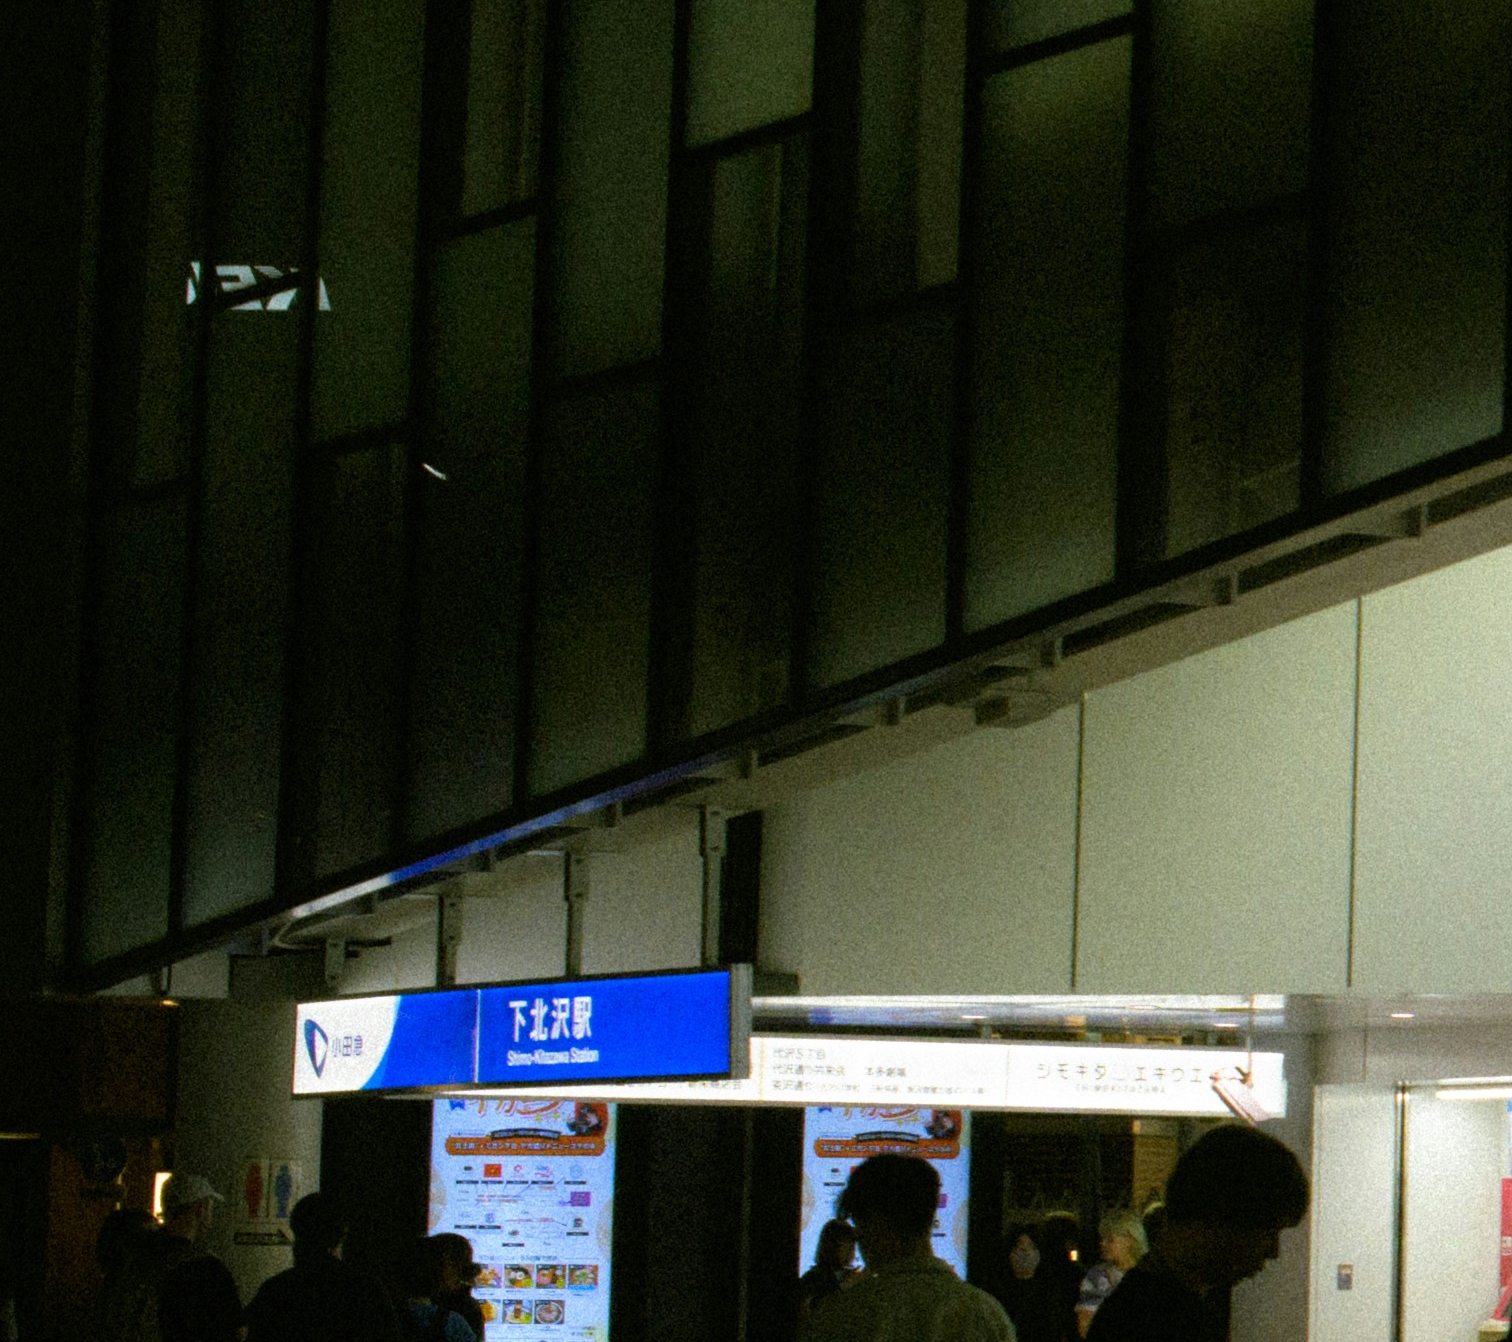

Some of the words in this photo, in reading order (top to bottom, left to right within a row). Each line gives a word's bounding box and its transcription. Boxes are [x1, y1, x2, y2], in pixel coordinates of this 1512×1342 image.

[509, 996, 593, 1043] 下北沢駅
[332, 1035, 364, 1058] 小田急
[507, 1048, 570, 1067] Shimo-Kitazawa
[571, 1048, 599, 1064] Station
